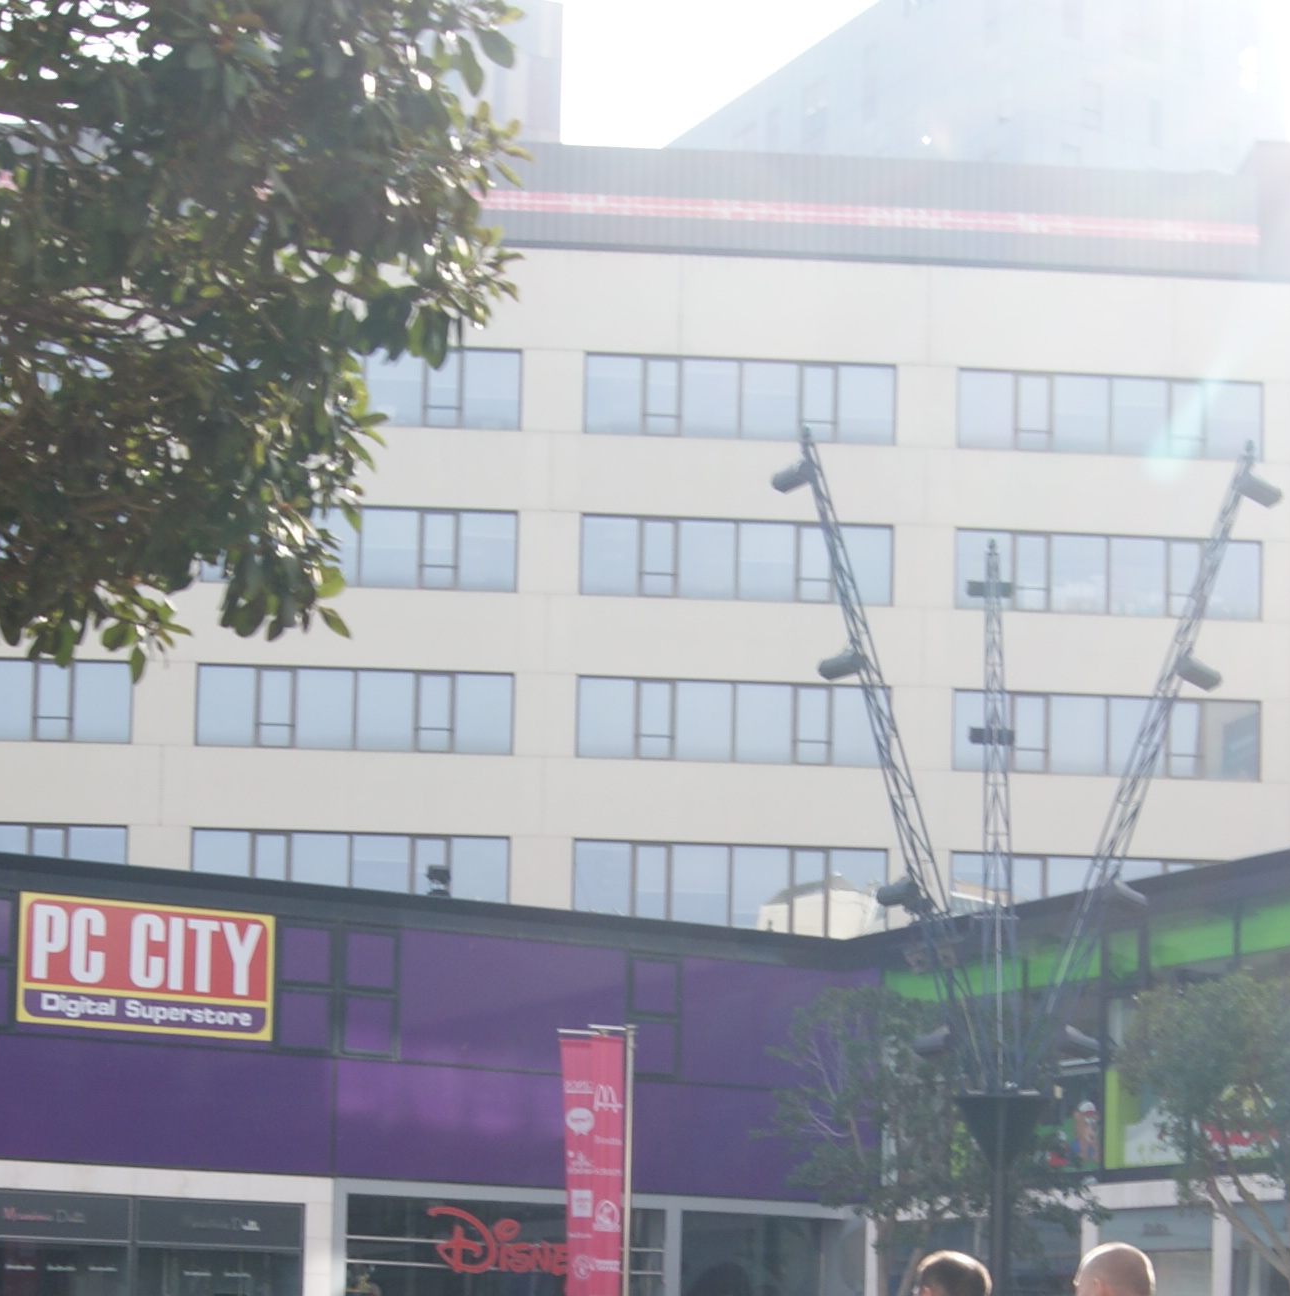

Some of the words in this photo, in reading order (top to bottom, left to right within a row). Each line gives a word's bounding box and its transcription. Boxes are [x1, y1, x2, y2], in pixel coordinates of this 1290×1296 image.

[31, 903, 107, 984] PC
[129, 912, 264, 996] CITY
[40, 992, 117, 1019] Digital
[124, 999, 253, 1026] Superstore
